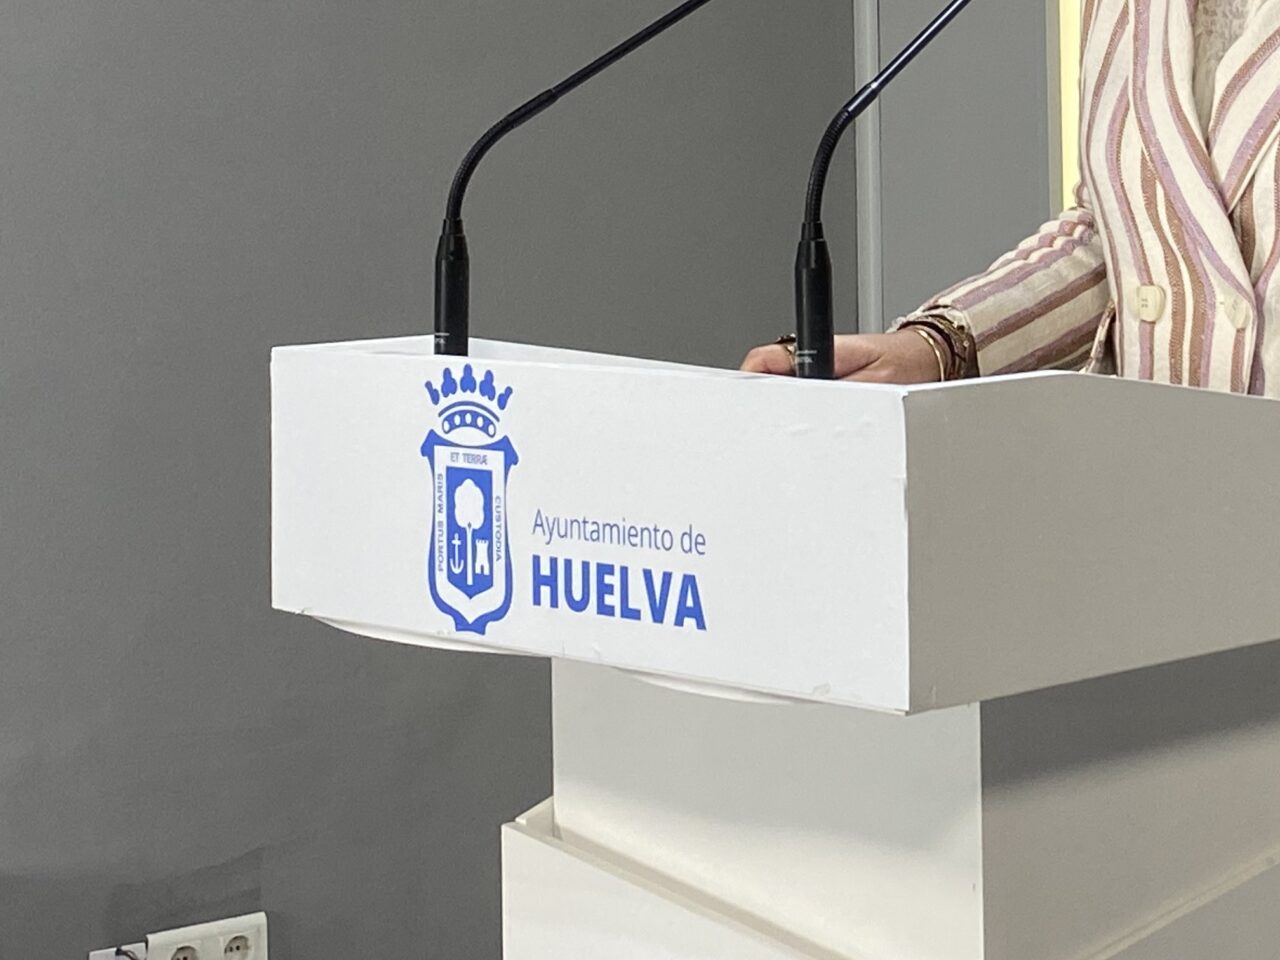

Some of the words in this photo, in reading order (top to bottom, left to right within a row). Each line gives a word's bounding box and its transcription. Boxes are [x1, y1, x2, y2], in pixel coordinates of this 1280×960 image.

[450, 452, 460, 462] ET
[532, 509, 674, 552] Ayuntamiento
[680, 524, 707, 555] de
[532, 554, 707, 631] HUELVA
